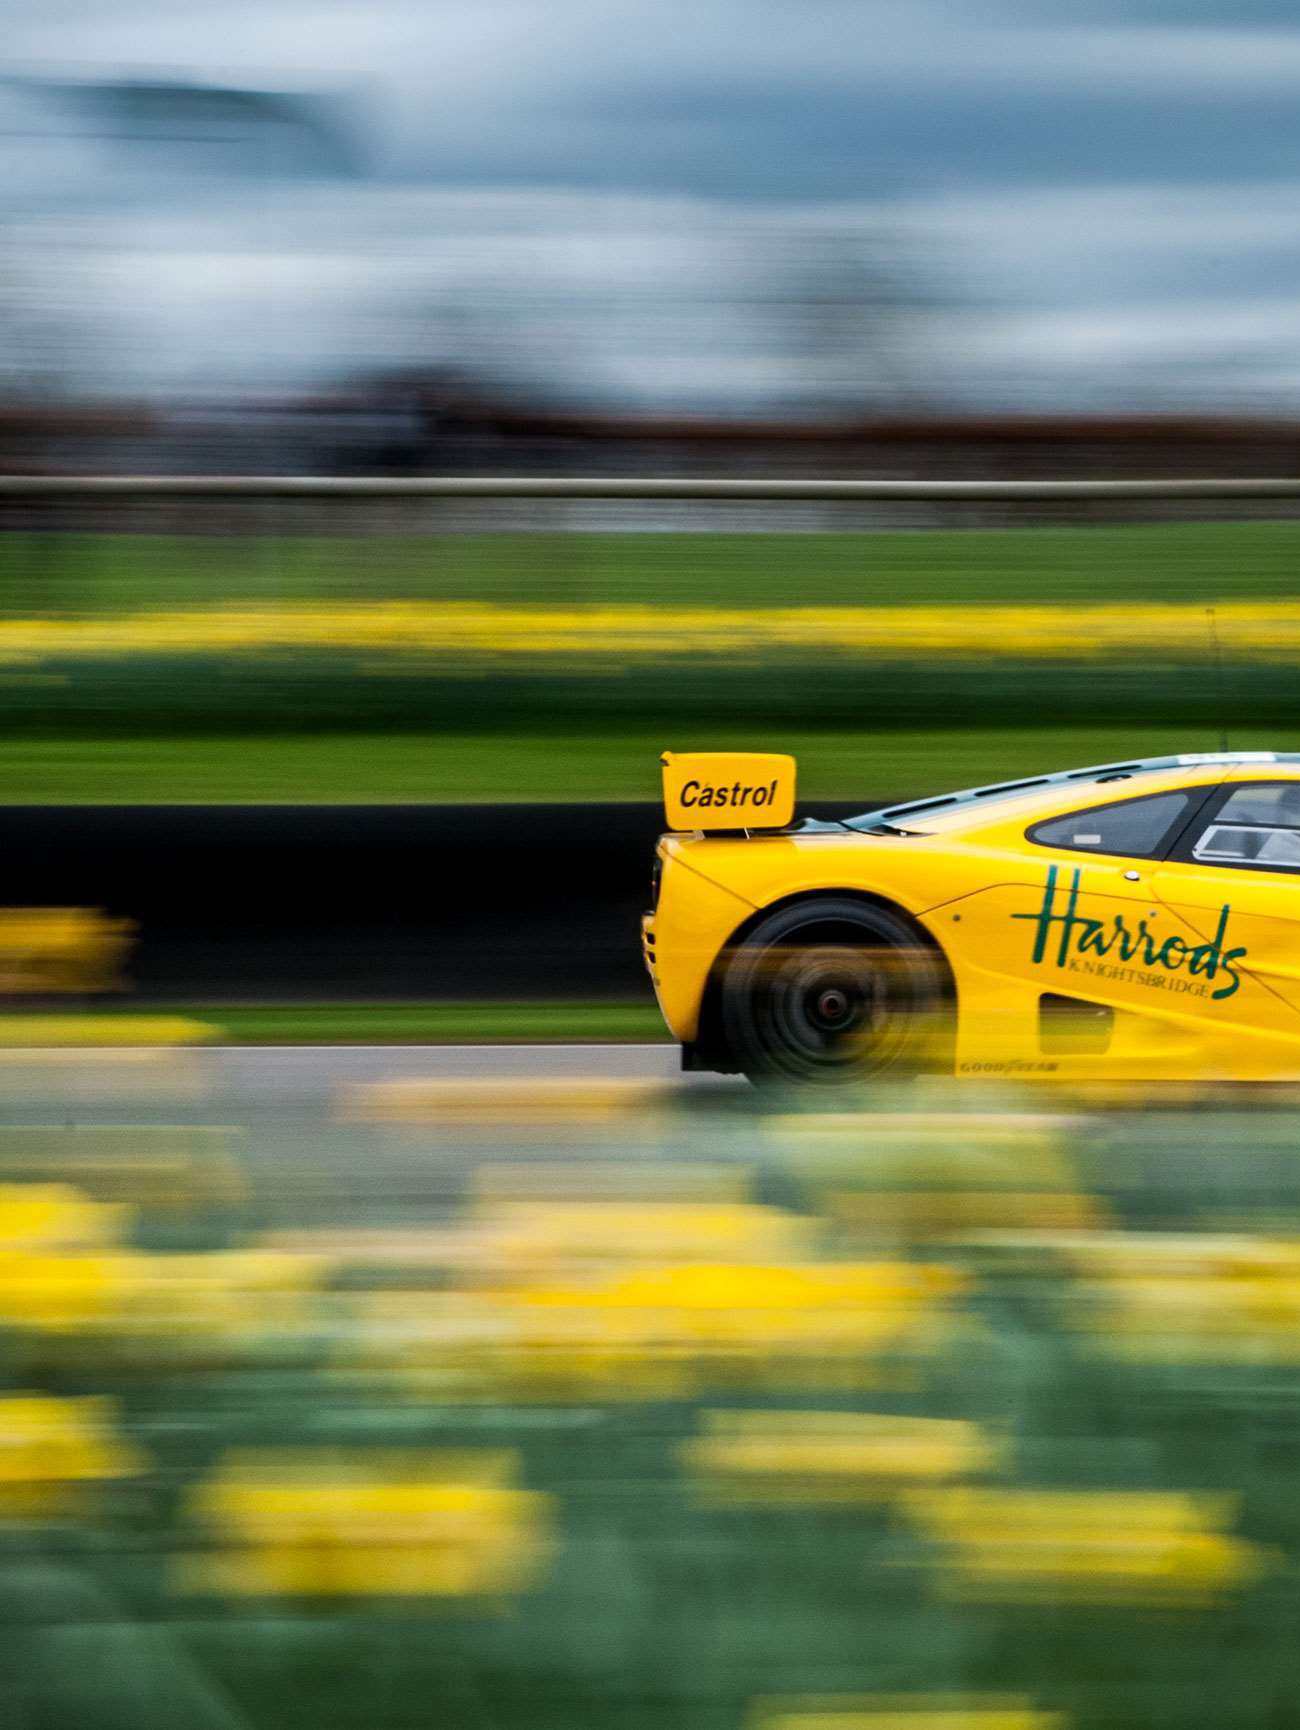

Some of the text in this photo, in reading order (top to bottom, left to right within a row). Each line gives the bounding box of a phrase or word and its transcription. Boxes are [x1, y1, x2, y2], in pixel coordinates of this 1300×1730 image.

[680, 780, 778, 807] Castrol
[1010, 865, 1247, 1000] Harrods
[1068, 958, 1209, 998] KNIGHTSBRIDGE
